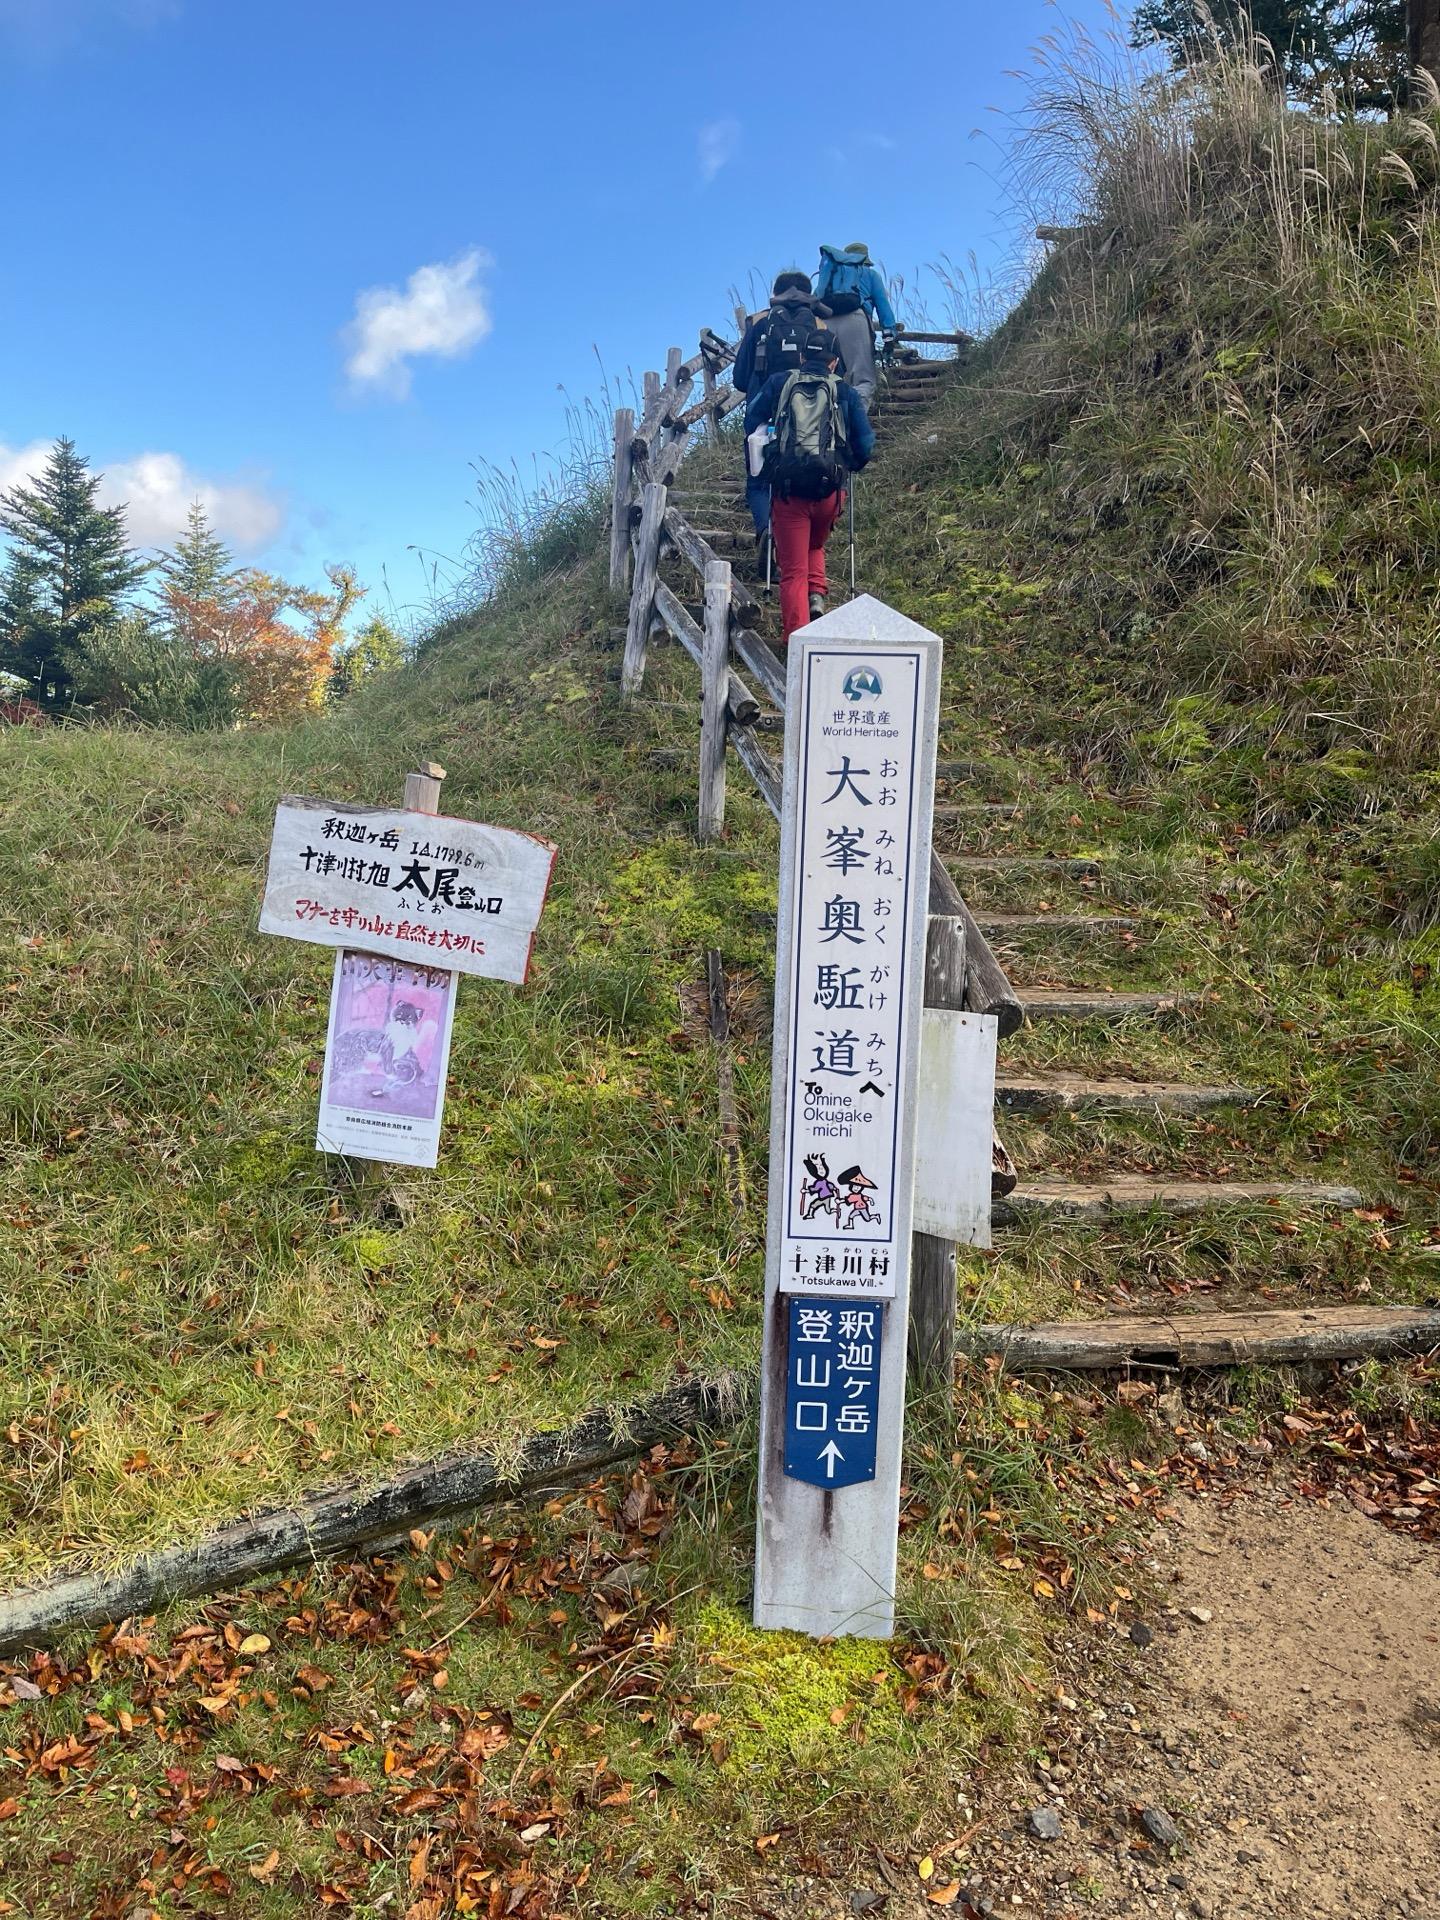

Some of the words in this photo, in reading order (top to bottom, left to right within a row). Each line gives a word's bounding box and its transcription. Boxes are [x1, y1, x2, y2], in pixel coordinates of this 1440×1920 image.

[832, 709, 891, 725] 世界遺産
[822, 726, 852, 736] World
[854, 727, 899, 738] Heritage
[397, 897, 445, 914] ふとお
[804, 1081, 823, 1095] To
[804, 1092, 852, 1107] Omine
[803, 1107, 873, 1123] Okugake
[788, 1253, 890, 1276] 十津川村
[800, 1275, 856, 1287] Totsukawa
[859, 1278, 877, 1288] Vill.
[795, 1309, 833, 1431] 登山口
